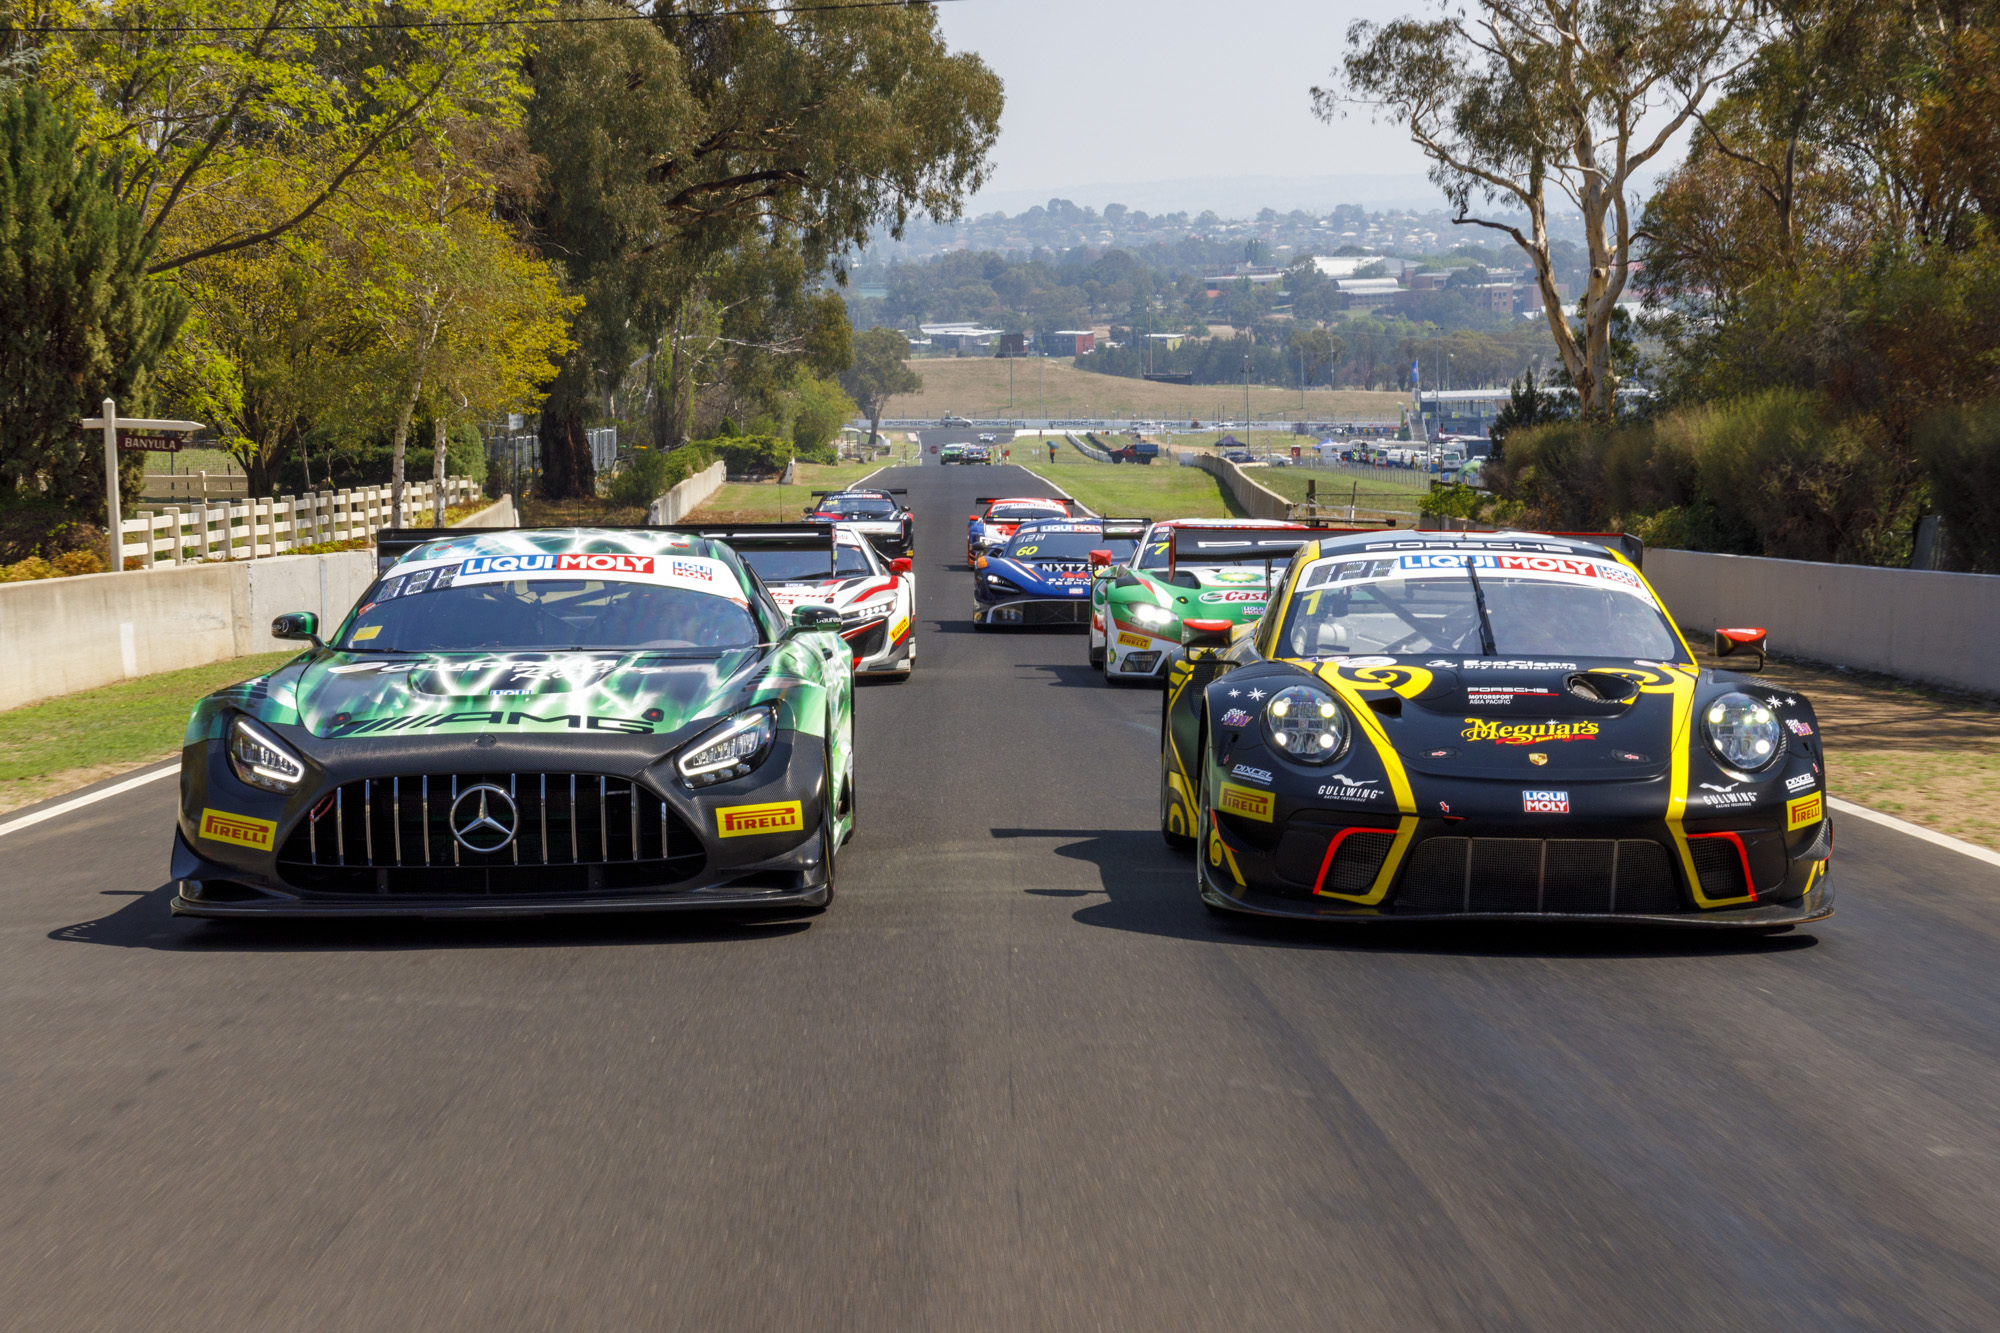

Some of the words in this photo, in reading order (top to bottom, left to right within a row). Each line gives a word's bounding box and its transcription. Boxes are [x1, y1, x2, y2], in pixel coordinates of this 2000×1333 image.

[124, 437, 177, 450] BANYULA
[1016, 545, 1039, 556] 60
[1154, 542, 1170, 555] 7
[1365, 541, 1574, 554] PORSCHE
[464, 555, 555, 574] LIQUI
[559, 556, 652, 572] MOLY
[674, 562, 712, 575] LIQUI
[1404, 555, 1496, 568] LIQUI
[1500, 556, 1592, 575] MOLY
[674, 568, 712, 582] MOLY
[1599, 565, 1638, 581] LIQUI
[1602, 572, 1640, 588] MOLY
[1302, 590, 1323, 616] 1
[1120, 634, 1149, 648] PIRELLI
[1463, 659, 1577, 667] EcoClean
[424, 711, 655, 734] AMG
[1460, 717, 1600, 744] Meguiar's
[1535, 735, 1553, 743] Since
[1233, 764, 1273, 779] DIXCEL
[1785, 773, 1814, 786] DIXCEL
[1317, 784, 1379, 799] GULLWING
[1525, 791, 1566, 801] LIQUI
[1702, 791, 1757, 805] GULLWING
[1222, 787, 1269, 815] PIRELLI
[1526, 801, 1568, 811] MOLY
[1791, 798, 1820, 824] PIRELLI
[724, 807, 796, 831] PIRELLI
[205, 815, 270, 844] PIRELLI
